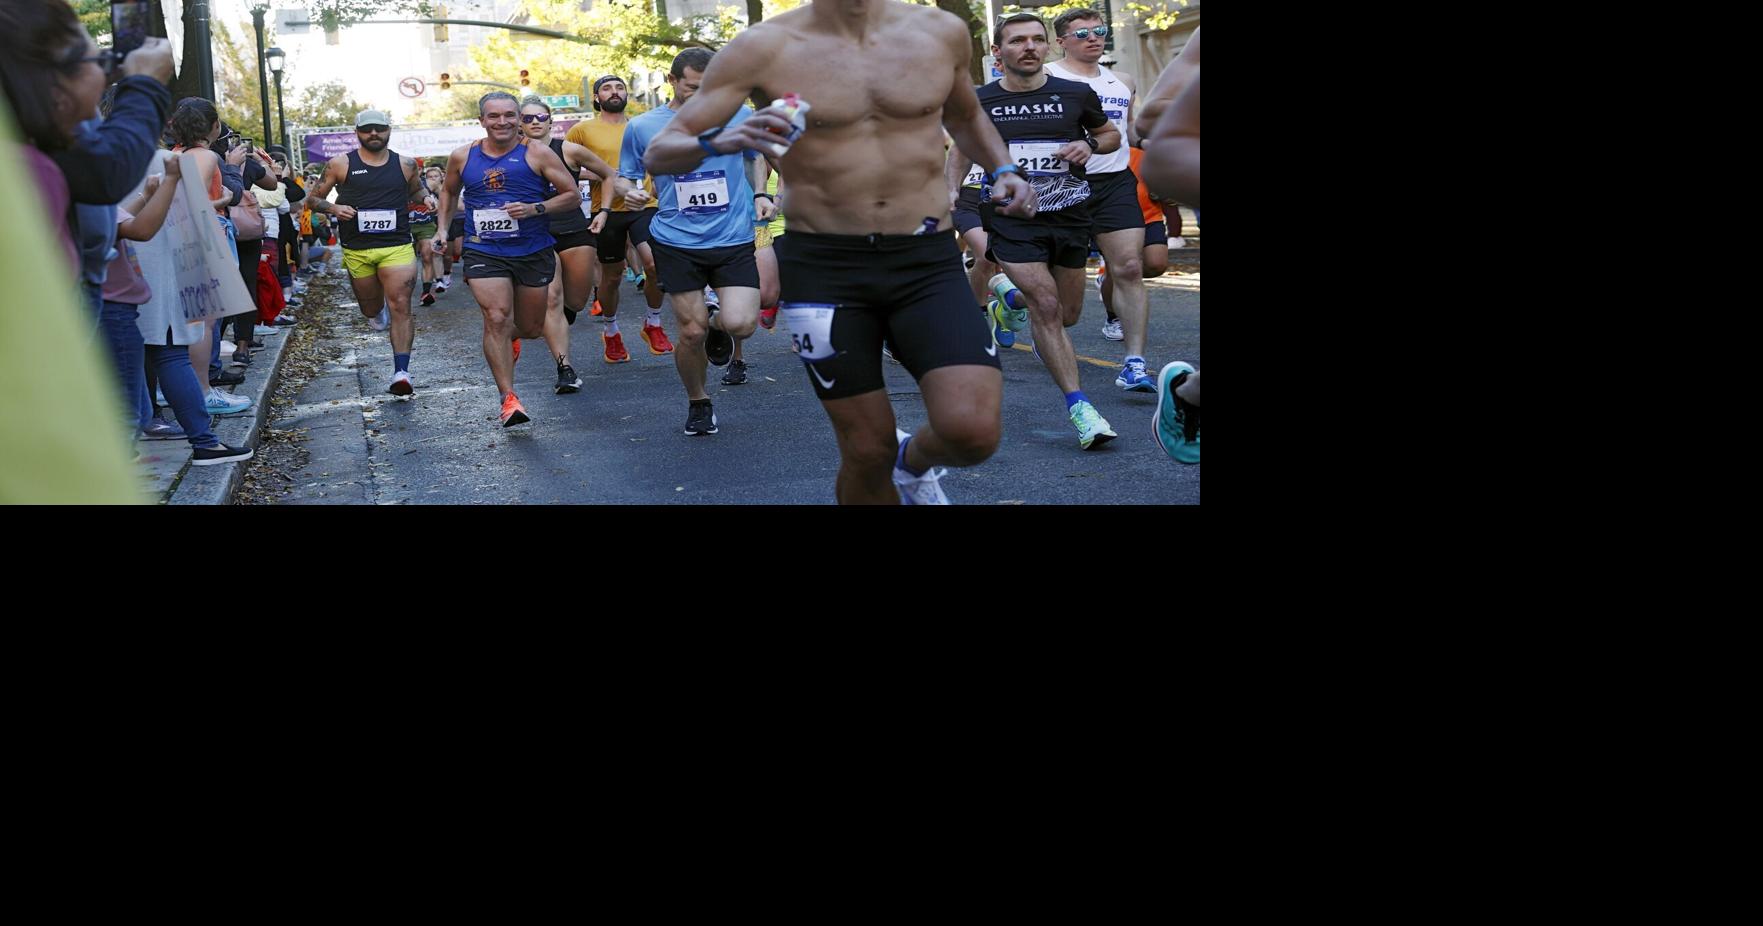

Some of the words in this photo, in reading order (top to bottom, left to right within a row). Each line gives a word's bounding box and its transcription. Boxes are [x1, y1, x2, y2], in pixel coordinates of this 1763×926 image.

[991, 103, 1063, 116] CHASKI
[1018, 157, 1062, 170] 2122
[969, 172, 984, 182] 27
[689, 192, 718, 206] 419
[363, 220, 392, 230] 2787
[480, 219, 513, 231] 2822
